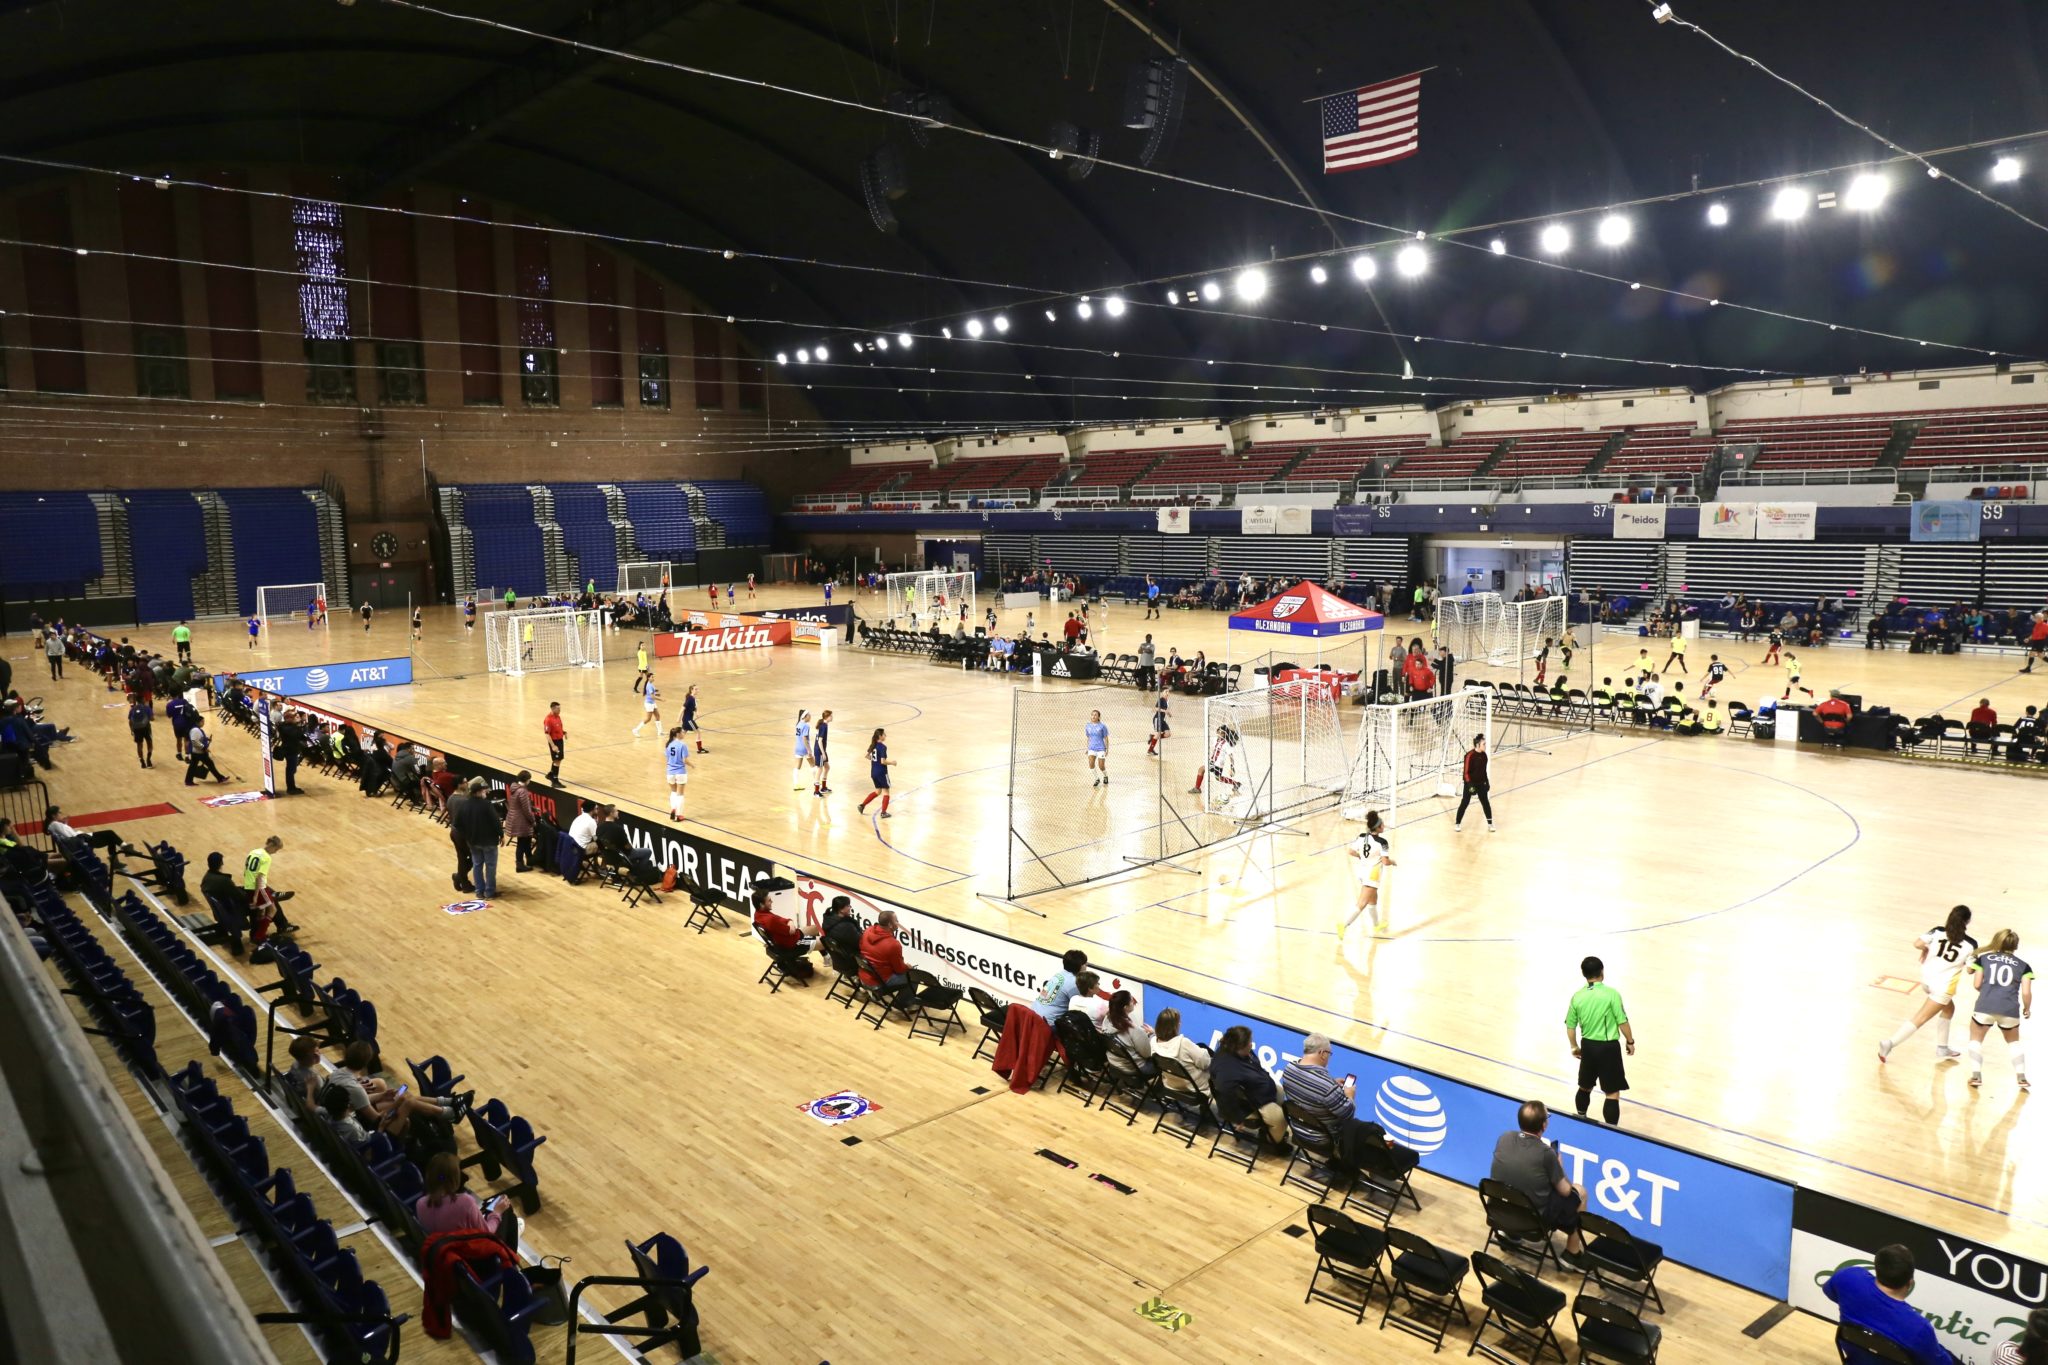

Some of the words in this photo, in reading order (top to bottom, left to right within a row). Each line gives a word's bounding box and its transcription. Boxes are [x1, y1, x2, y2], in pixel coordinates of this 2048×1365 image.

[1379, 506, 1391, 518] S5
[1593, 505, 1607, 518] S7
[1983, 505, 2003, 520] S9
[1632, 515, 1659, 525] leidos
[1255, 619, 1291, 633] ALEXANDRIA
[350, 666, 389, 683] AT&T
[1051, 669, 1072, 678] adidas
[670, 746, 676, 757] 5
[623, 824, 700, 886] MAJOR
[1936, 939, 1963, 963] 15
[1989, 963, 2014, 987] 10
[1541, 1137, 1680, 1227] T&T
